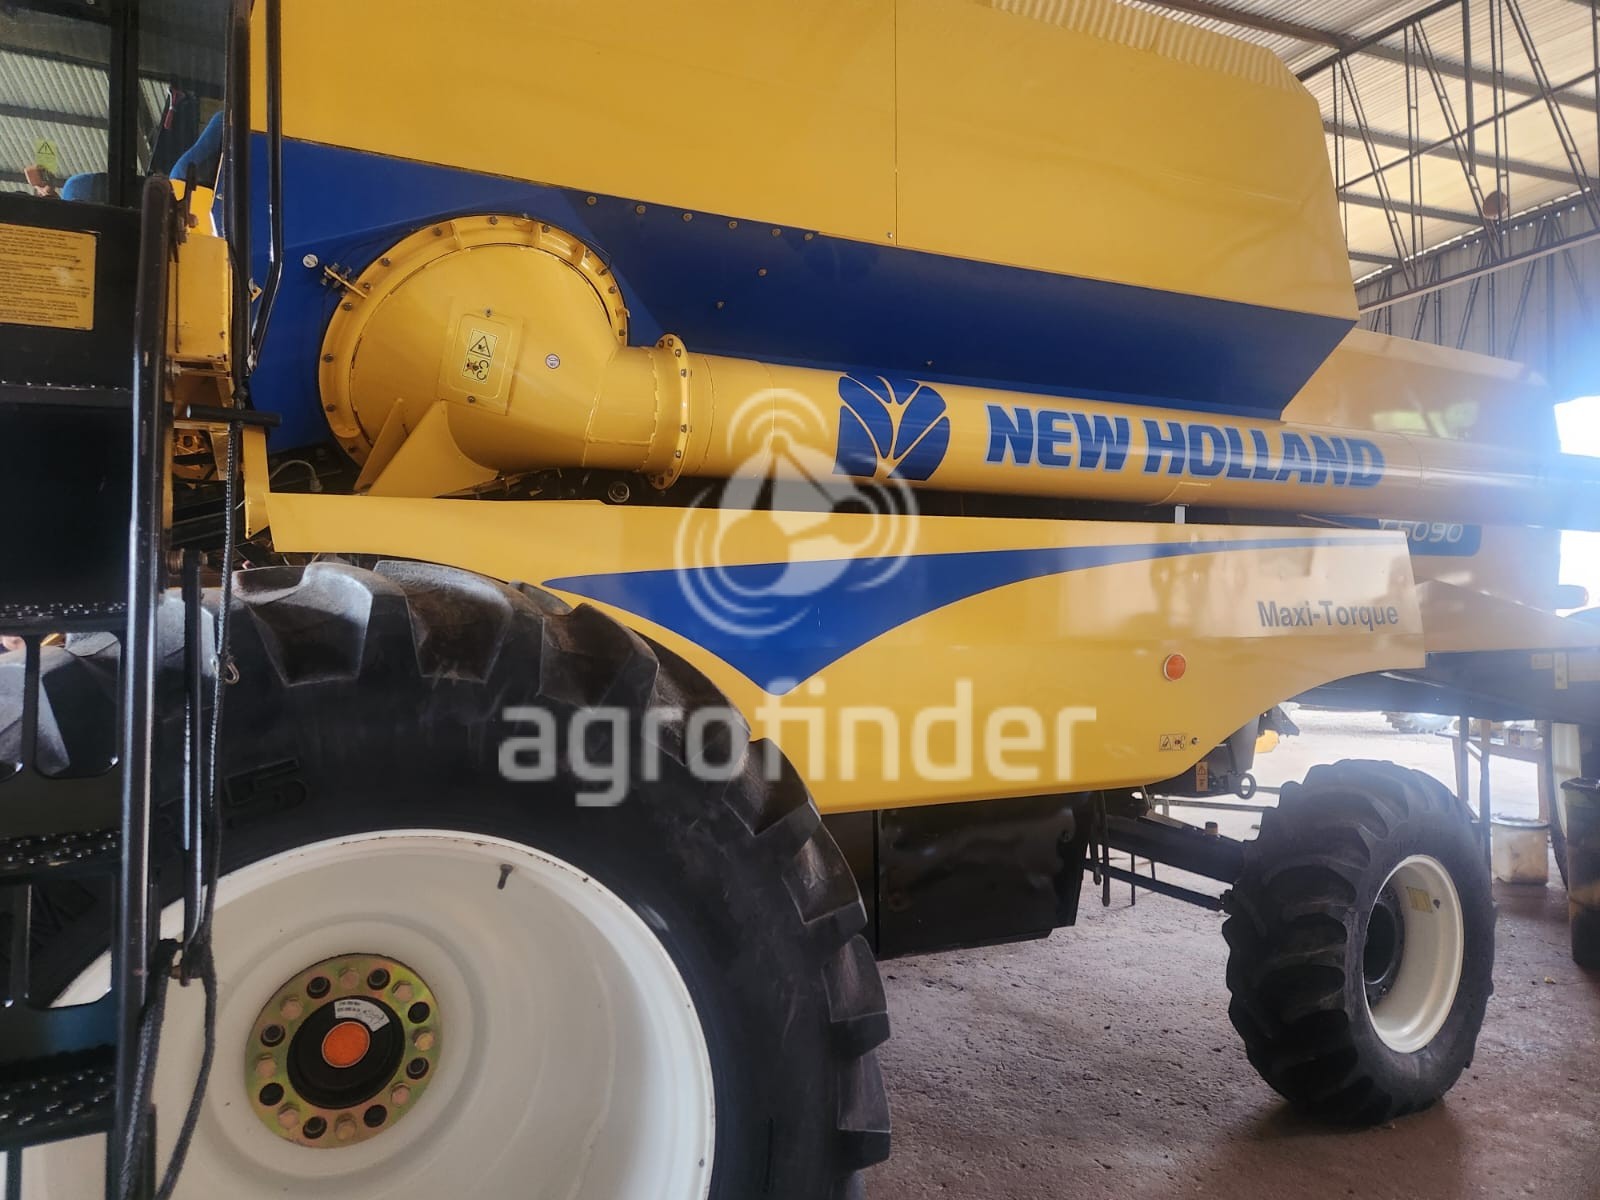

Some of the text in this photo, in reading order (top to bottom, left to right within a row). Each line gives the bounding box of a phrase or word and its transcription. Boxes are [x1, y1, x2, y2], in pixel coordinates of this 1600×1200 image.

[985, 402, 1386, 489] NEW HOLLAND
[1256, 600, 1400, 632] Maxi-Torque
